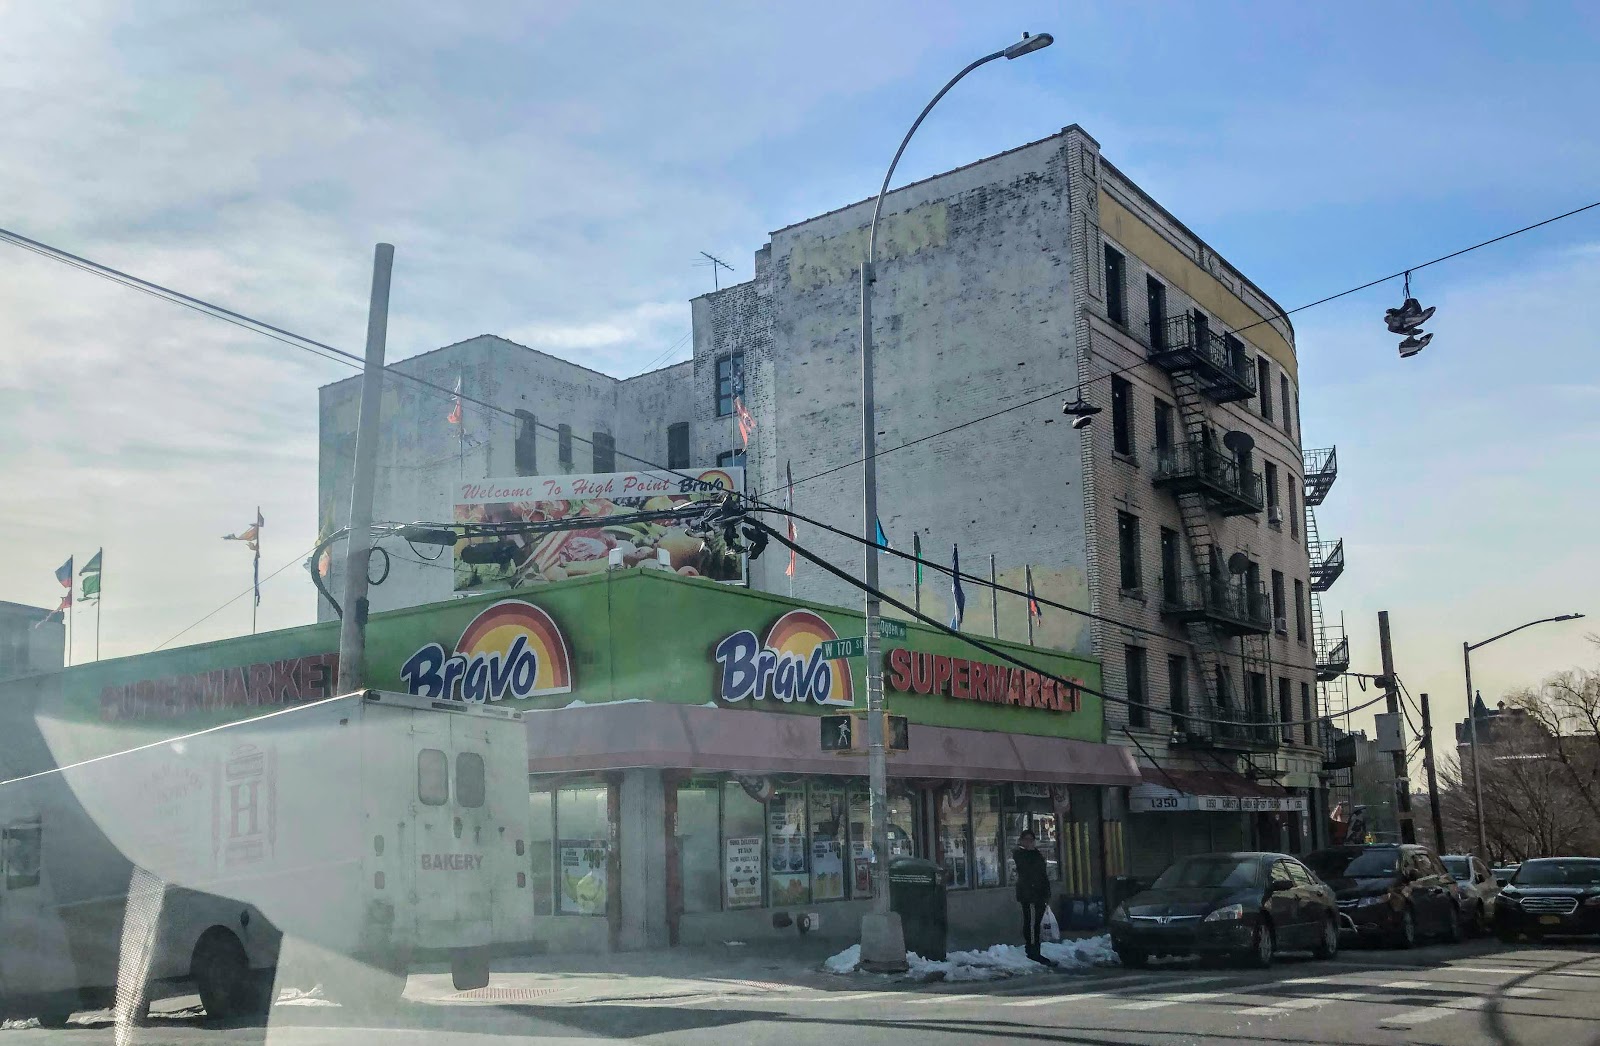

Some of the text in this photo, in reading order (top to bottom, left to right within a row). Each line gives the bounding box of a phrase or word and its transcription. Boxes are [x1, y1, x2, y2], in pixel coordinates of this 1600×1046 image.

[461, 476, 724, 499] Welcome To High Point Bravo
[824, 642, 833, 657] W
[837, 640, 852, 656] 170
[400, 633, 538, 704] Bravo
[715, 629, 1085, 713] Bravo SUPERMARKET
[1151, 798, 1178, 808] 1350
[421, 853, 484, 871] BAKERY
